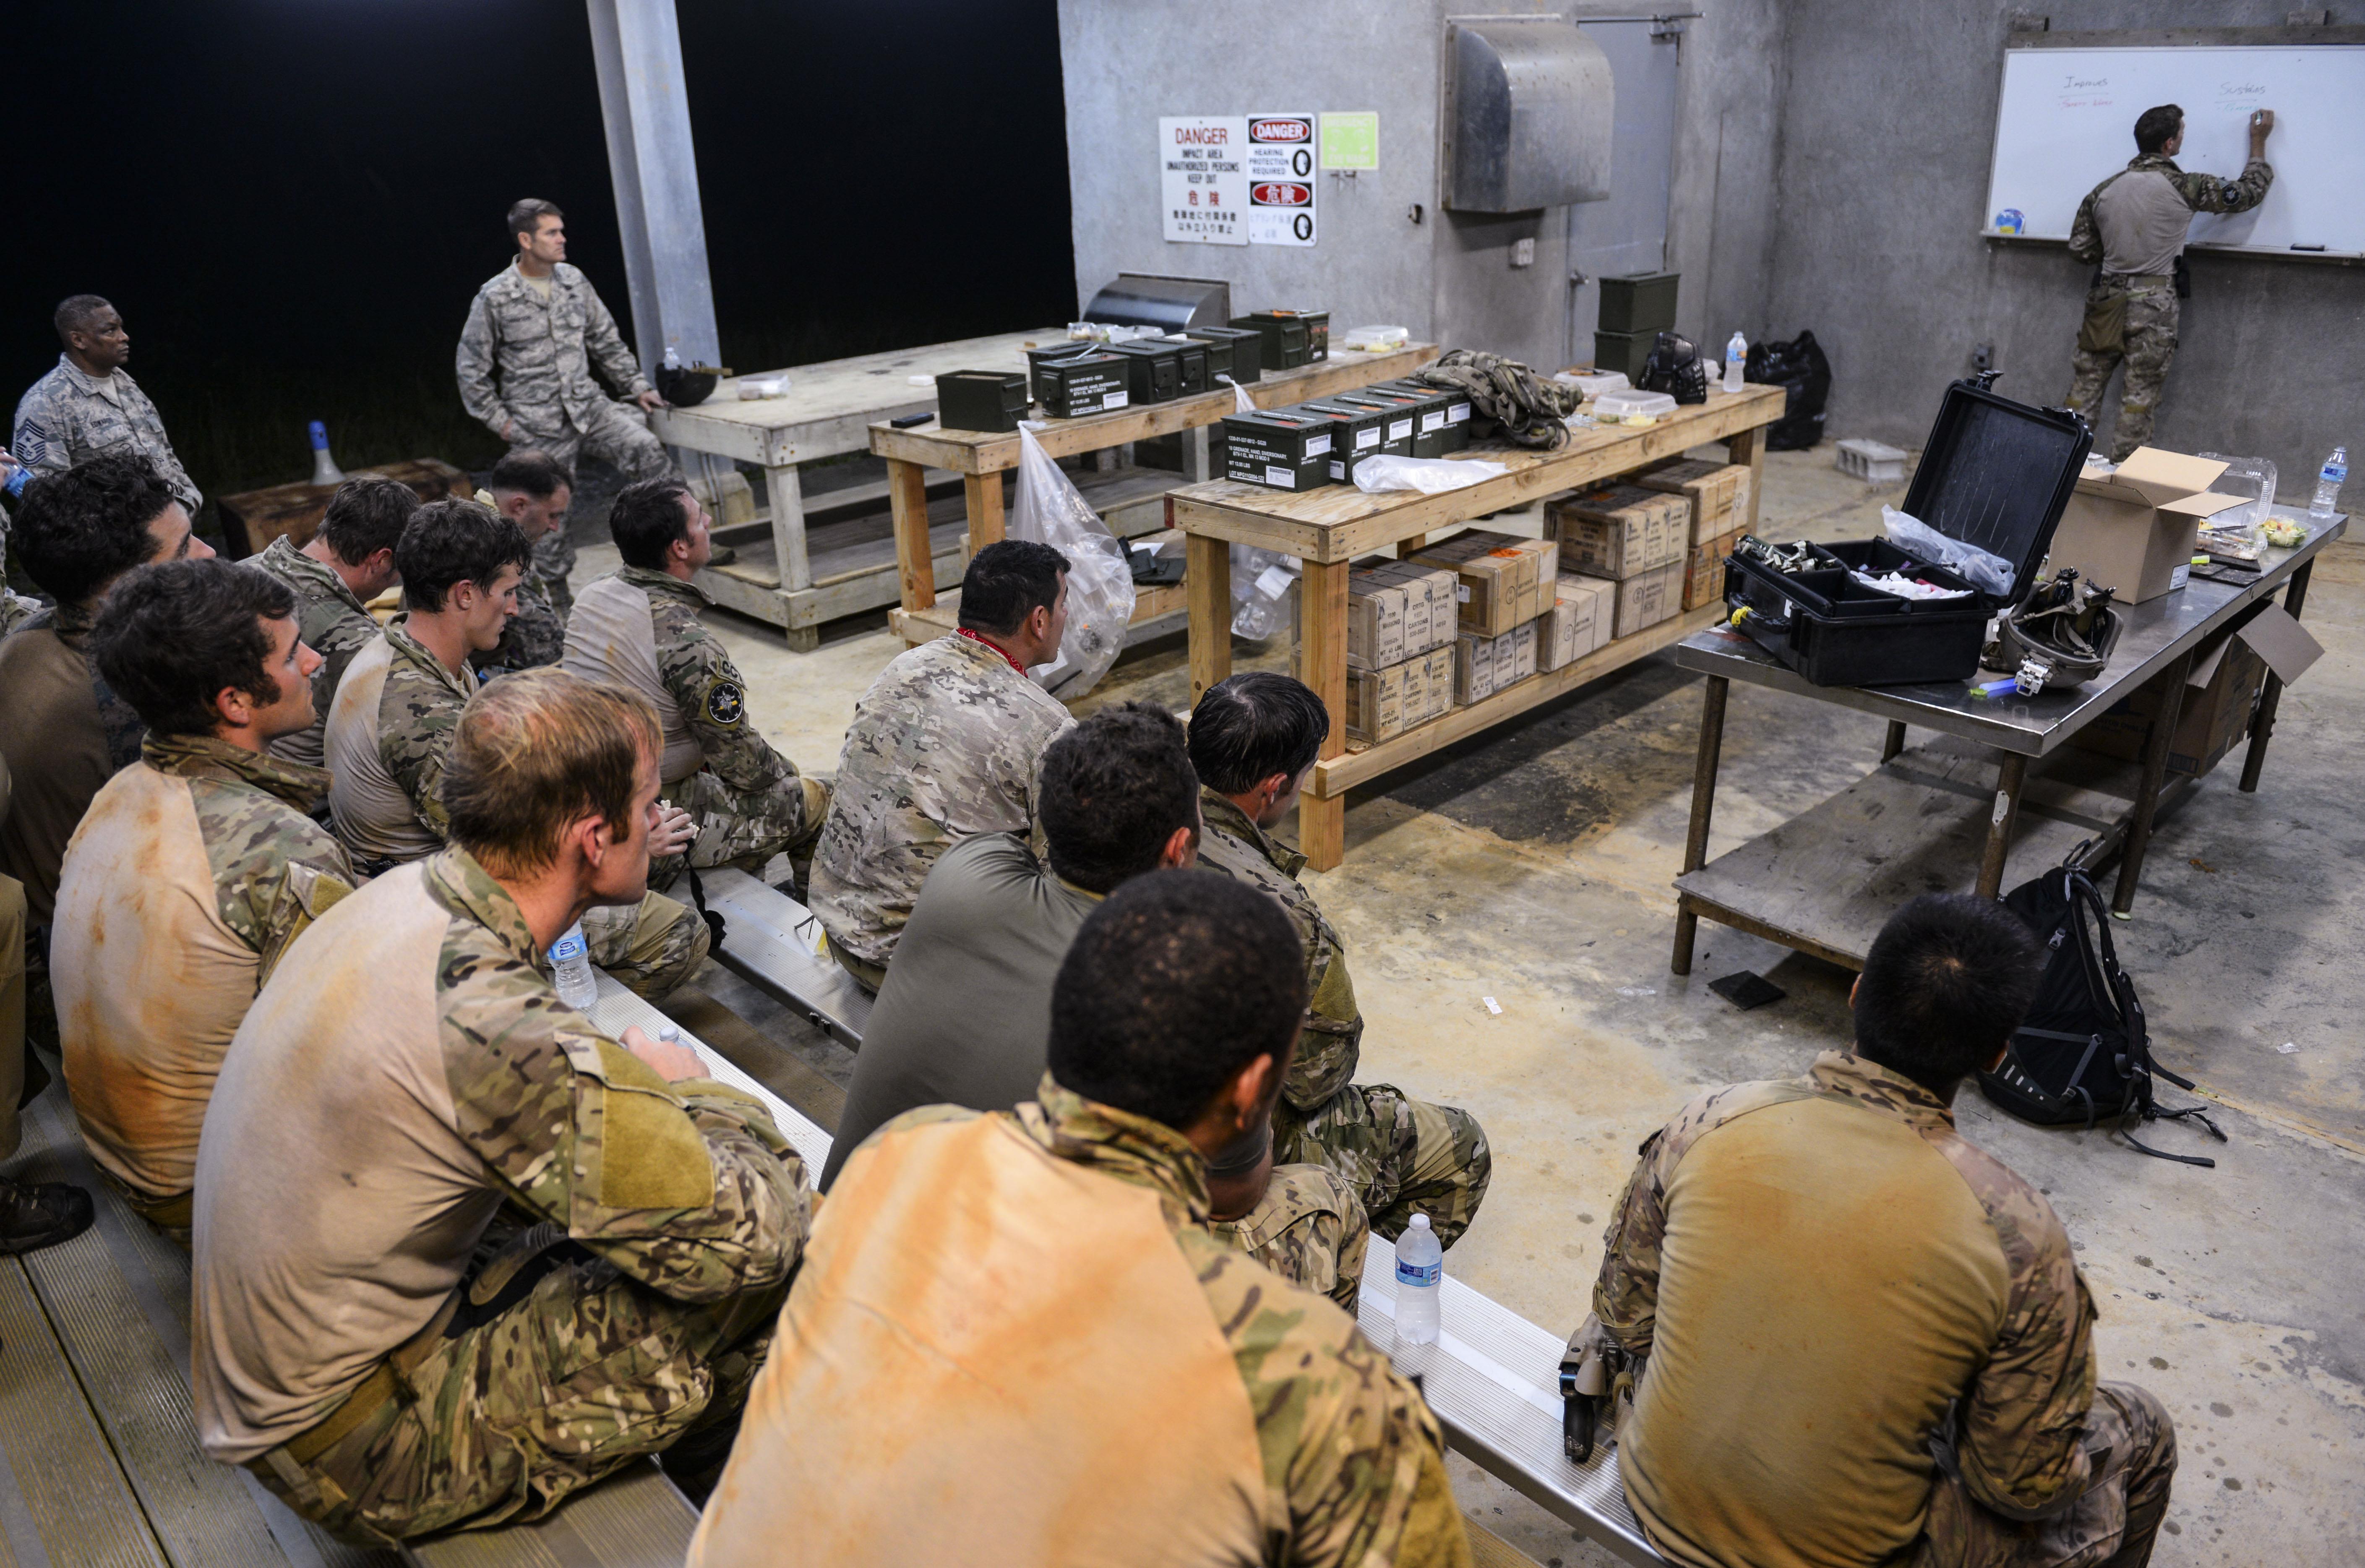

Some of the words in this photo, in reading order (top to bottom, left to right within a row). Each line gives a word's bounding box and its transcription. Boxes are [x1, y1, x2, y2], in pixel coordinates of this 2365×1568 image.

[1175, 127, 1228, 144] DANGER
[1257, 123, 1303, 138] DANGER
[1207, 149, 1222, 158] AREA
[1212, 161, 1239, 172] PERSONS
[1252, 167, 1285, 175] REQUIRED
[1188, 173, 1202, 183] KEEP
[1205, 174, 1216, 184] OUT
[1266, 184, 1296, 204] 危険
[1262, 450, 1287, 460] DIVERSIONARY,
[1412, 602, 1424, 611] CRTG
[1408, 618, 1429, 629] CARTONS
